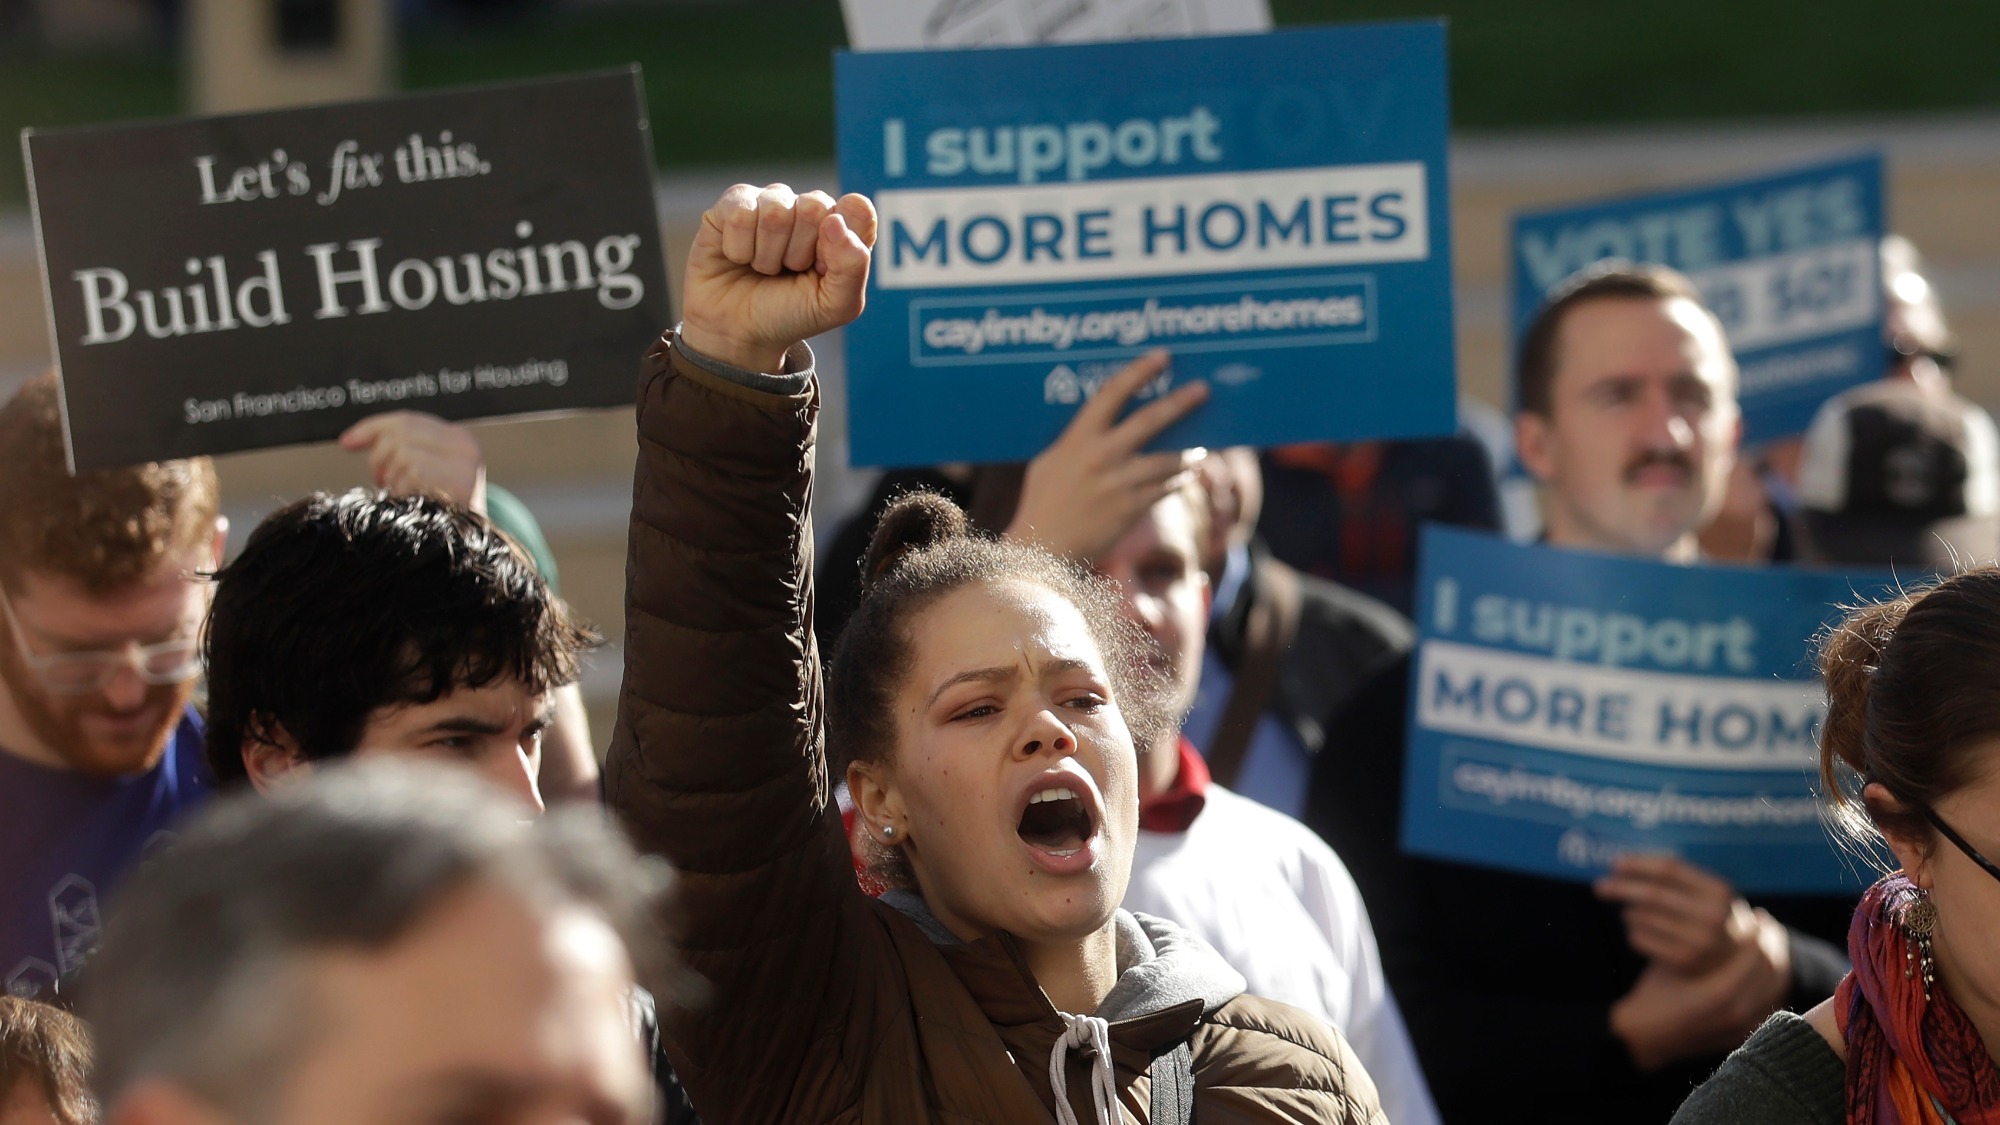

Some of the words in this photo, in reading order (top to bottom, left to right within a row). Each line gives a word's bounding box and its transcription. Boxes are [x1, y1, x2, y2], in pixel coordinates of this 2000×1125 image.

[196, 147, 311, 205] Let's
[317, 139, 385, 207] fix
[395, 130, 492, 184] this.
[883, 117, 906, 178] I
[926, 106, 1223, 184] support
[889, 208, 1115, 269] MORE
[1142, 191, 1409, 257] HOMES
[1523, 206, 1710, 291] VOTE
[1731, 179, 1862, 257] YES
[73, 249, 291, 346] Build
[305, 220, 645, 319] Housing
[924, 293, 1365, 354] cayimby.org/morehomes
[184, 397, 233, 424] San
[233, 384, 347, 419] Francisco
[346, 371, 439, 404] Tenants
[439, 366, 472, 394] for
[474, 357, 569, 392] Housing
[1434, 575, 1459, 634] I
[1472, 592, 1756, 670] support
[1432, 668, 1629, 742] MORE
[1658, 704, 1822, 755] HOM
